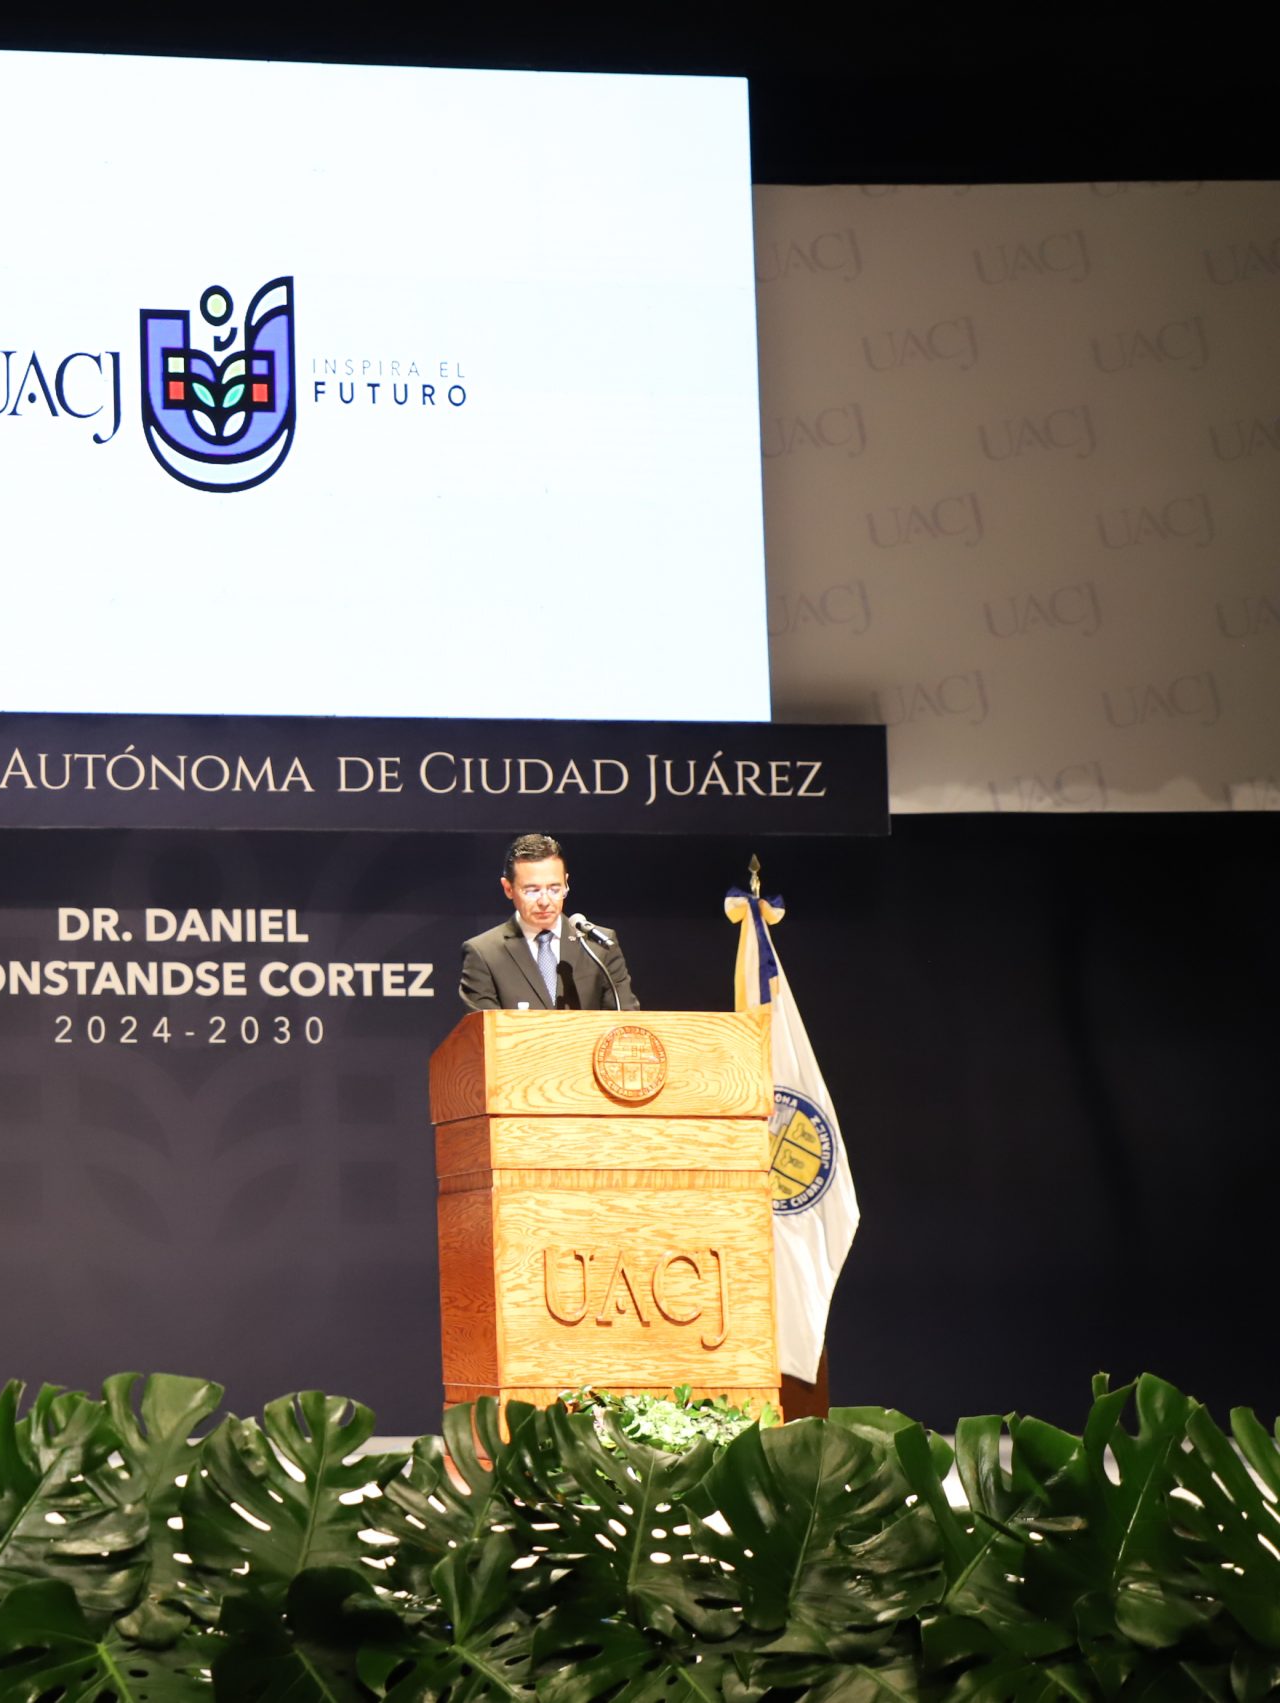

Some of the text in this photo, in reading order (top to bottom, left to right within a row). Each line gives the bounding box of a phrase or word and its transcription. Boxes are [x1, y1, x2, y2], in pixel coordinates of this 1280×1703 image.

[973, 229, 1090, 285] UACJ
[1203, 240, 1280, 287] UA
[312, 358, 466, 379] INSPIRA EL
[862, 316, 979, 371] UACJ
[1091, 316, 1209, 373] UACJ
[314, 381, 467, 407] FUTURO
[978, 404, 1096, 461] UACJ
[1209, 418, 1280, 461] UA
[867, 493, 984, 548] UACJ
[1098, 493, 1215, 549] UACJ
[983, 581, 1102, 637] UACJ
[1216, 599, 1280, 638] UA
[1103, 671, 1220, 727] UACJ
[338, 756, 403, 793] DE
[419, 751, 629, 794] CIUDAD
[646, 751, 825, 805] JUÁREZ
[58, 907, 309, 943] DR. DANIEL
[259, 961, 435, 997] CORTEZ
[54, 1015, 324, 1045] 2024-2030
[544, 1247, 731, 1350] UACJ
